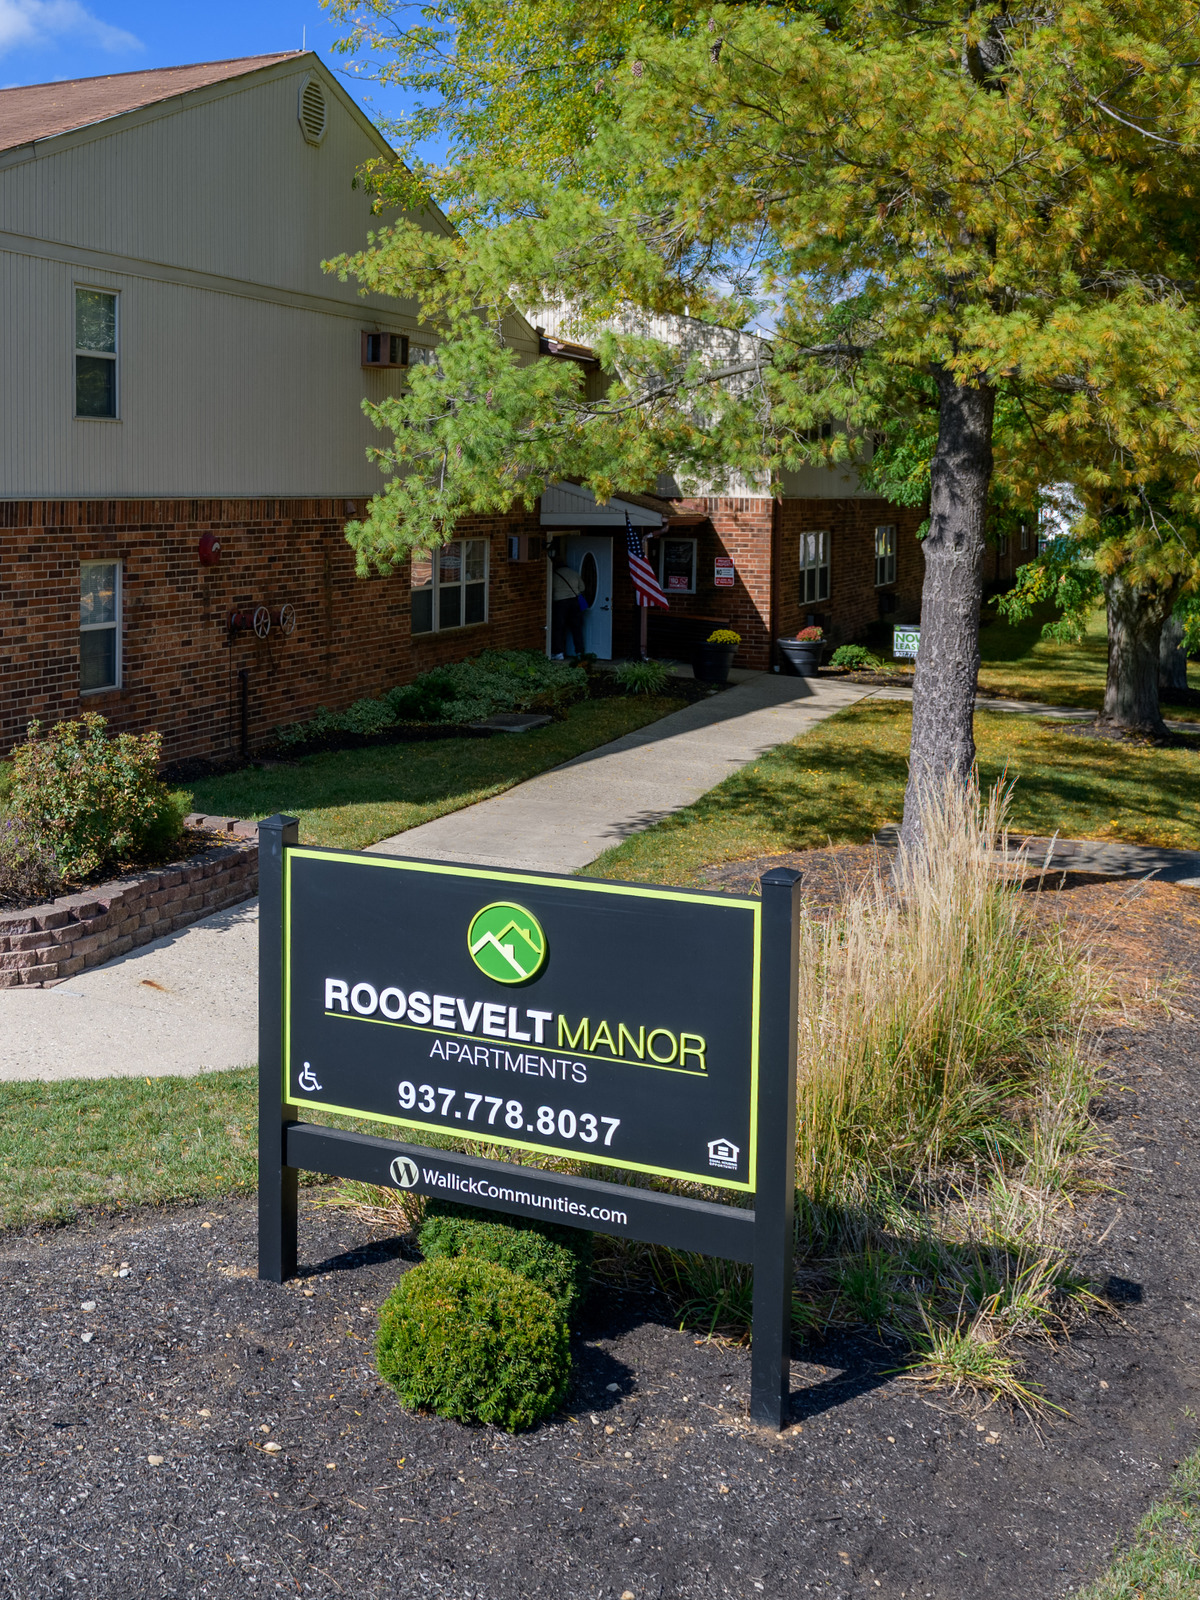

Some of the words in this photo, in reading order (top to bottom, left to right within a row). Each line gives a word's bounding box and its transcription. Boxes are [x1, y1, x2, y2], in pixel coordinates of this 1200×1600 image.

[324, 978, 553, 1045] ROOSEVELT
[557, 1014, 708, 1070] MANOR
[429, 1039, 588, 1084] APARTMENTS
[398, 1080, 621, 1146] 937.778.8037
[422, 1168, 628, 1225] WallickCommunities.com
